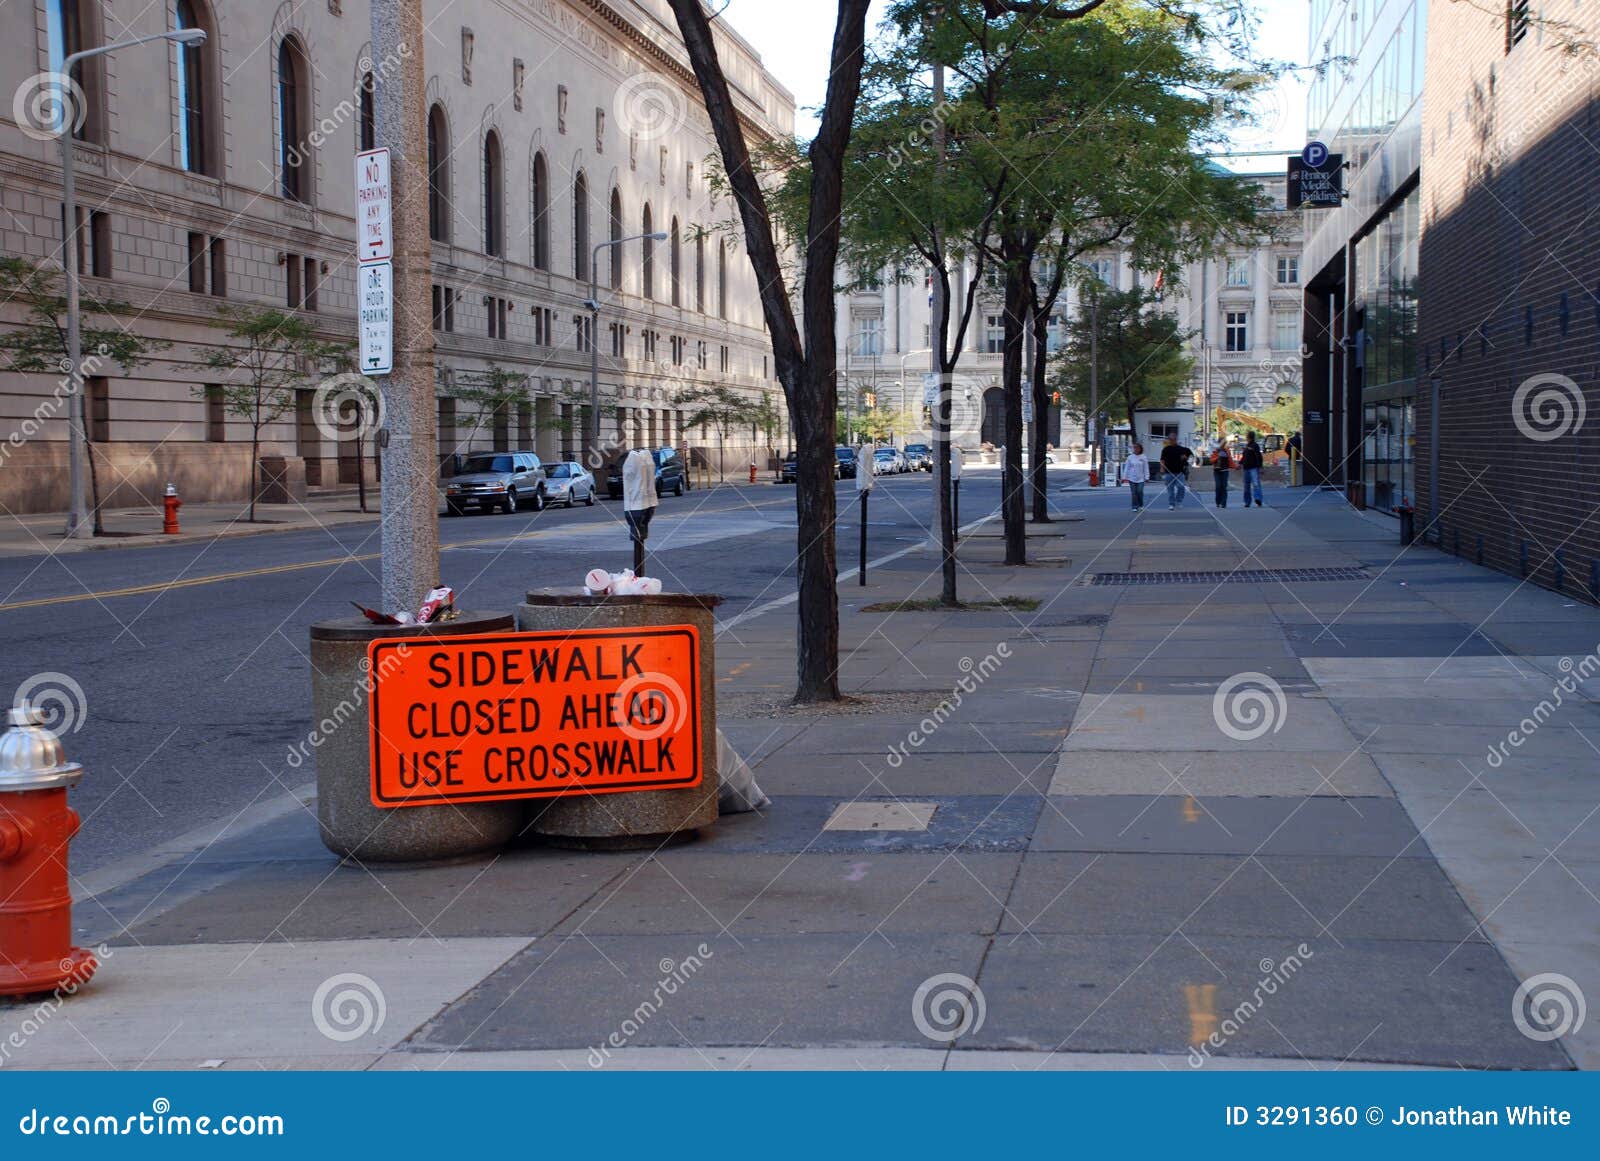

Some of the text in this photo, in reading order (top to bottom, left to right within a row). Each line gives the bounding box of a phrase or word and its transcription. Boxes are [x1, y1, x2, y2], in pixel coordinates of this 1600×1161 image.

[1309, 147, 1323, 163] P
[366, 163, 379, 184] NO
[1301, 180, 1330, 190] Media
[360, 185, 387, 204] PARKING
[1301, 191, 1338, 202] Building
[367, 205, 380, 219] ANY
[367, 222, 384, 237] TIME
[368, 273, 381, 289] ONE
[367, 291, 384, 306] HOUR
[363, 307, 388, 323] PARKING
[428, 644, 645, 689] SIDEWALK
[407, 691, 669, 739] CLOSED AHEAD
[399, 737, 676, 789] USE CROSSWALK
